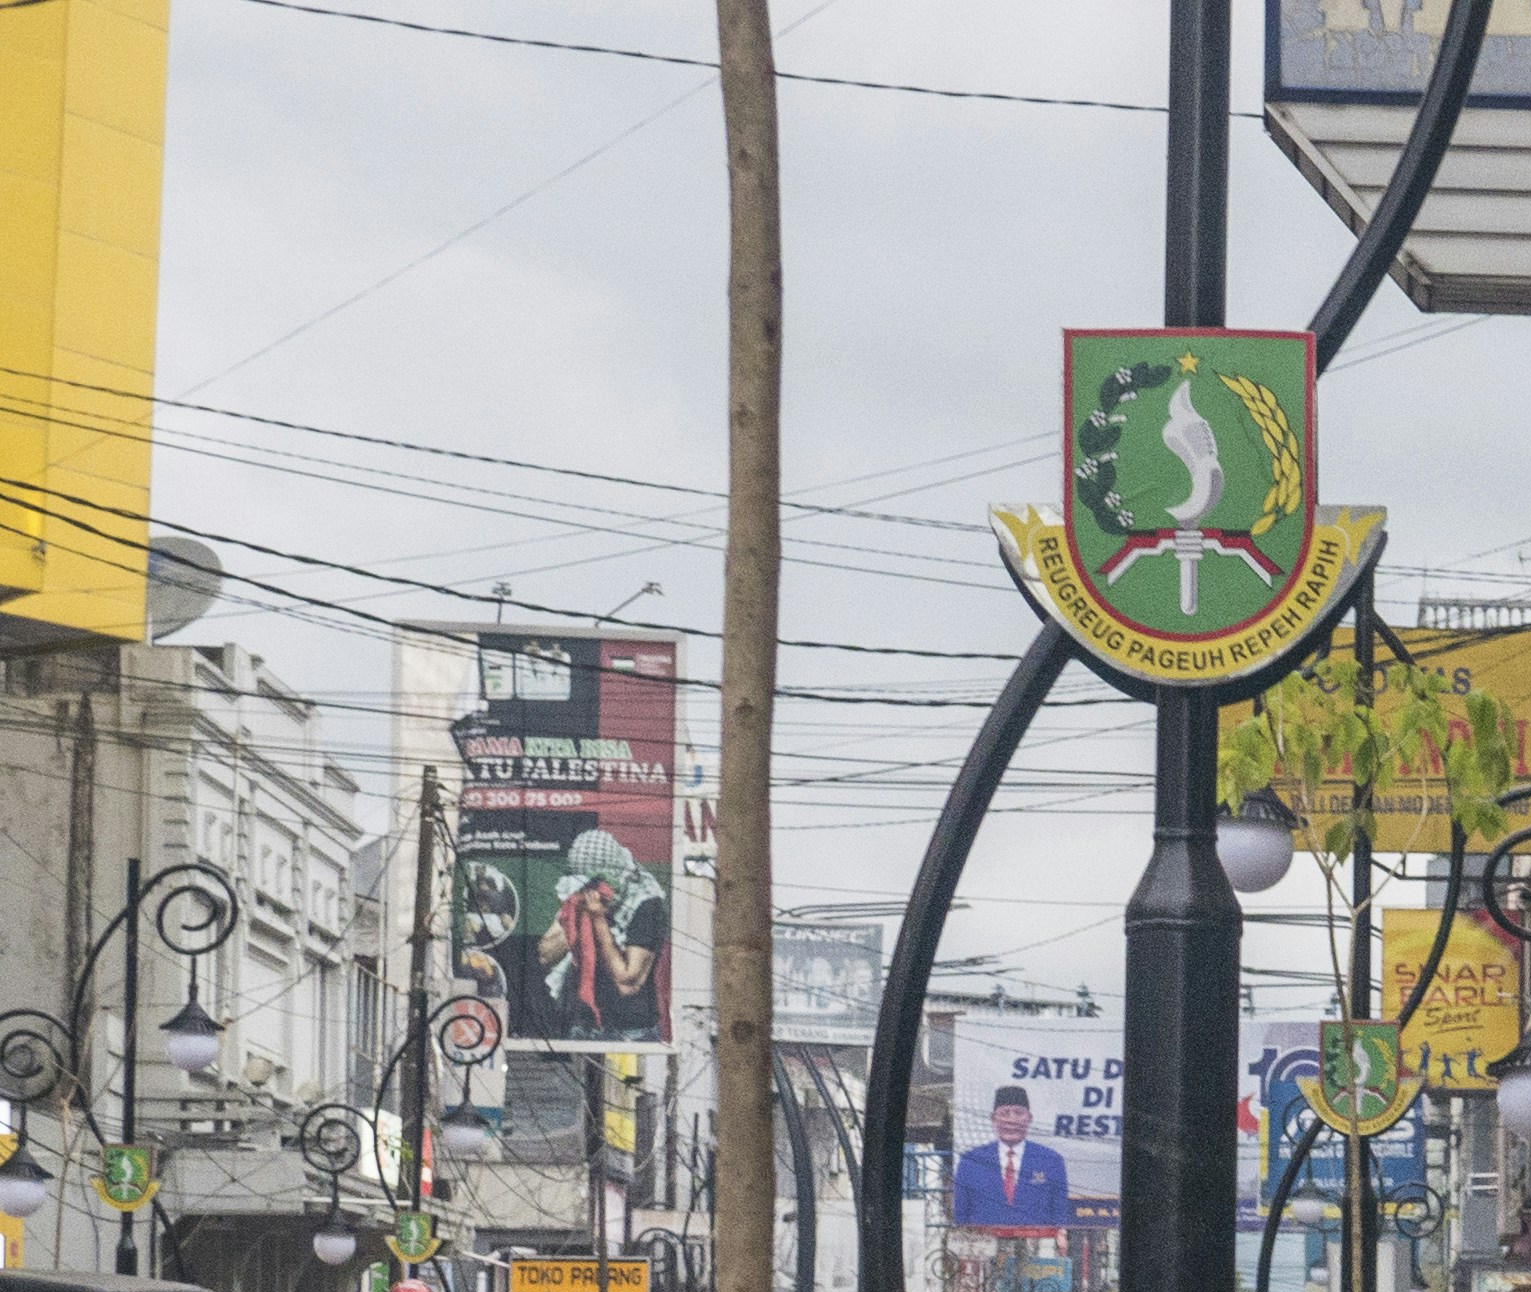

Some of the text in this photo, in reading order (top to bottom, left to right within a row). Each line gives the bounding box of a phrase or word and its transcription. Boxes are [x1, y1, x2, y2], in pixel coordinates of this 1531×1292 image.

[1038, 535, 1340, 671] REUGREUG PAGEUH REPEH RAPIH
[522, 758, 669, 784] PALESTINA
[1012, 1056, 1092, 1082] SATU
[1083, 1086, 1114, 1109] DI
[517, 1265, 643, 1286] TOKO PAANG
